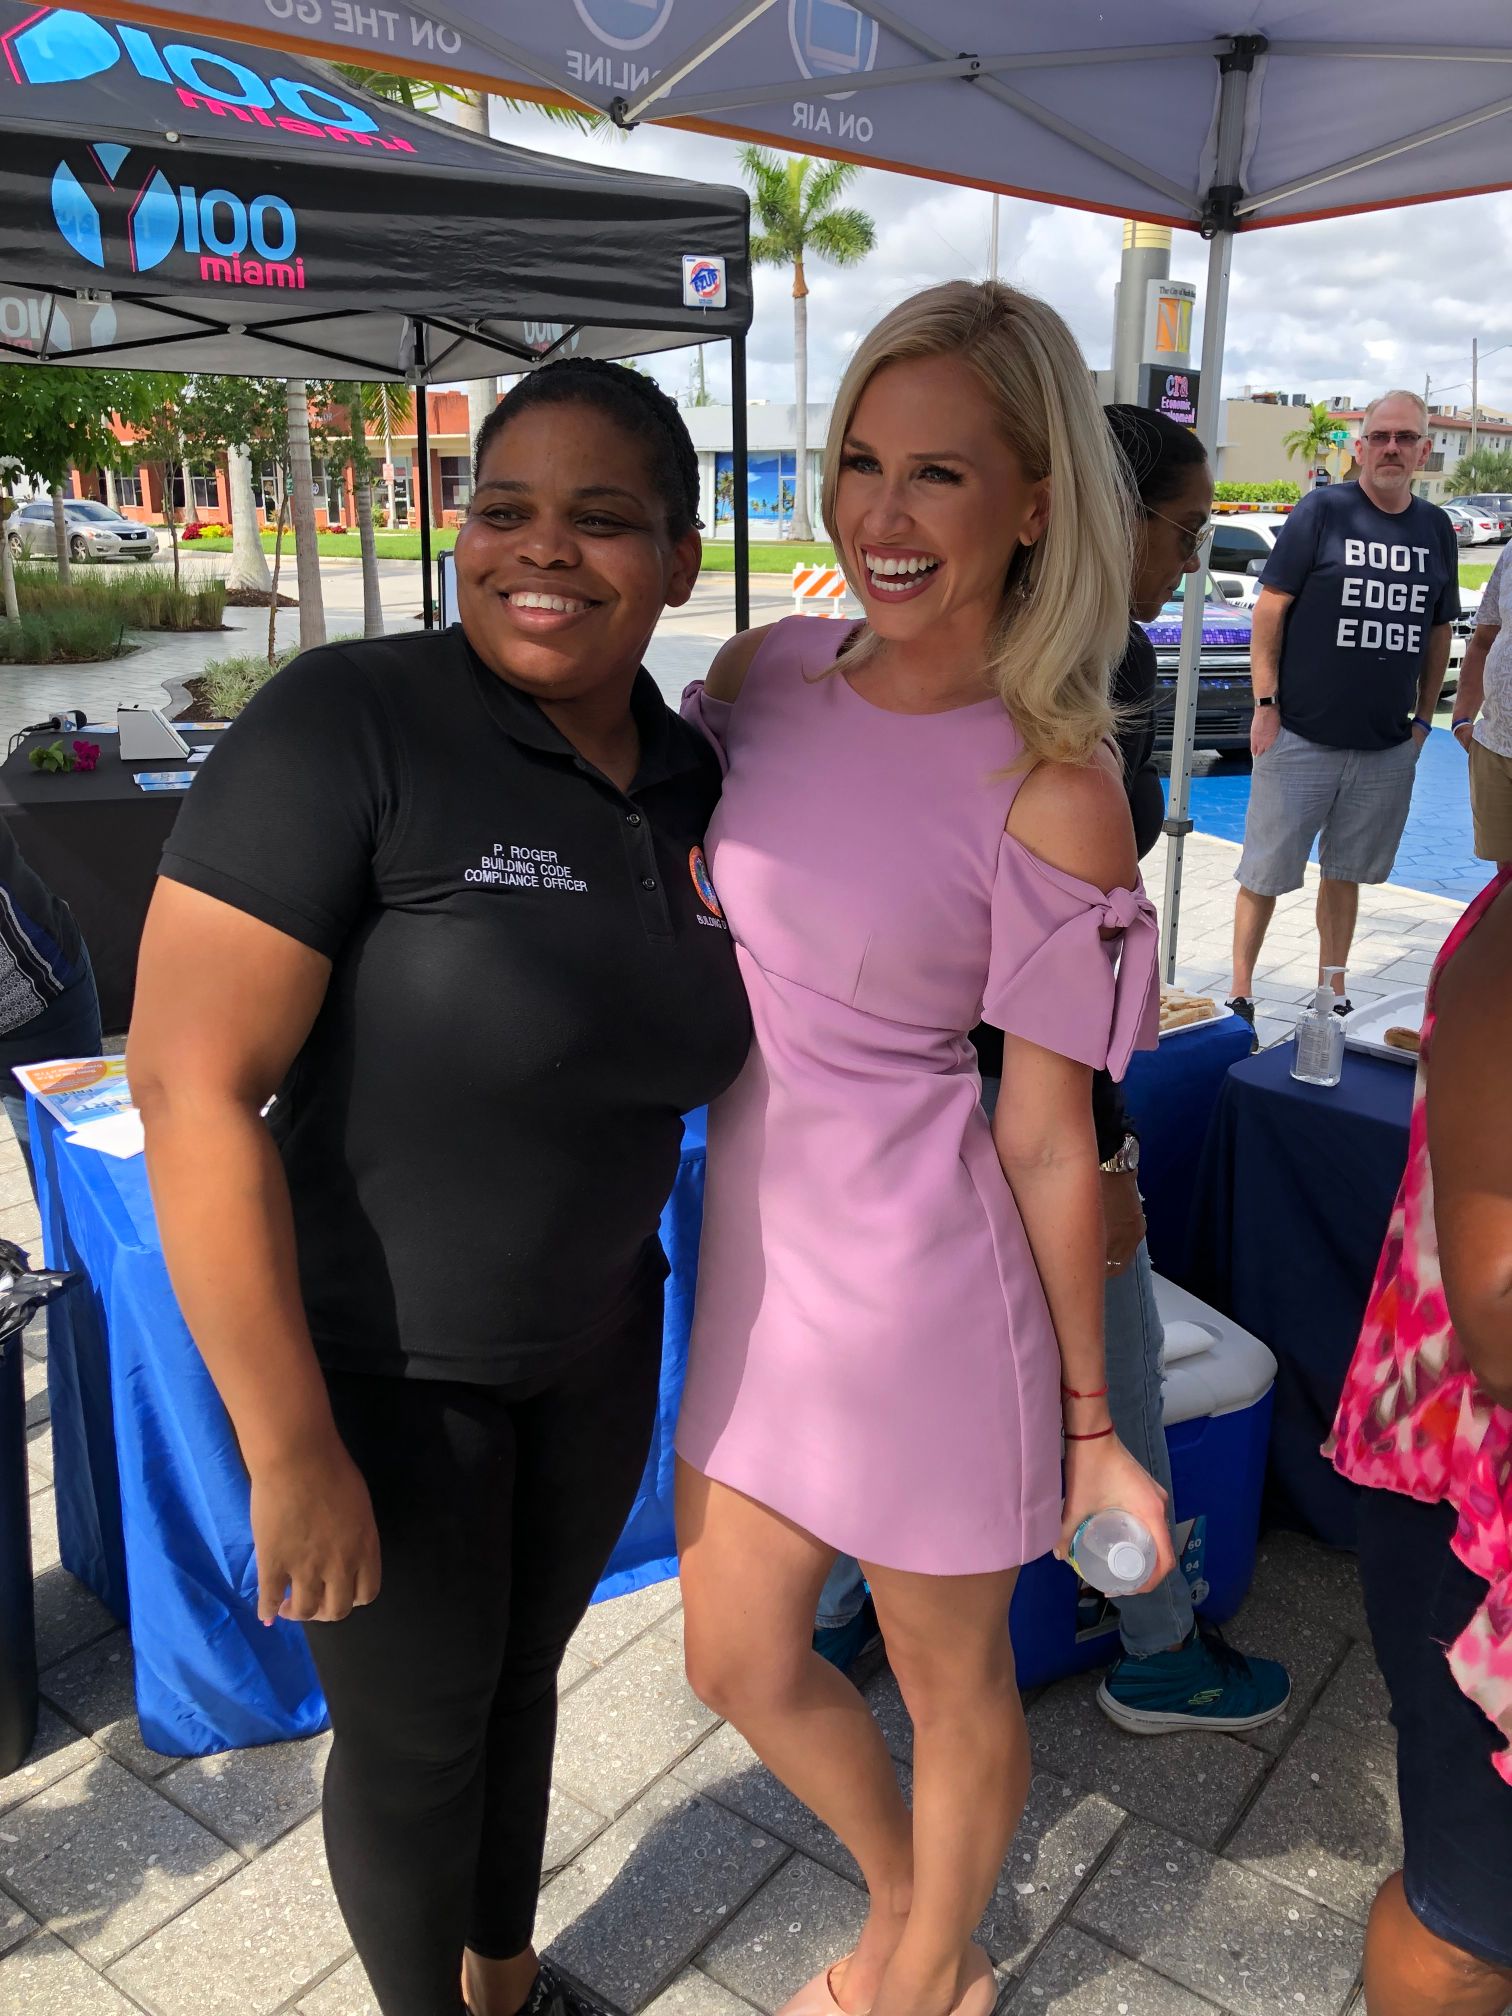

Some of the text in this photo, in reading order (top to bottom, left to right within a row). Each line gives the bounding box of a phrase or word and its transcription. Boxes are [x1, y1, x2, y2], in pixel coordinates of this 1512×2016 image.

[175, 87, 418, 154] miami
[200, 252, 305, 289] miami
[1165, 375, 1189, 397] cra
[1345, 538, 1430, 573] BOOT
[1341, 577, 1430, 614] EDGE
[1336, 618, 1422, 653] EDGE
[493, 843, 558, 863] P. ROGER
[481, 856, 572, 878] BUILDING CODE
[464, 868, 588, 892] COMPLIANCE OFFICER
[1187, 1538, 1201, 1550] 60
[1186, 1560, 1199, 1572] 94
